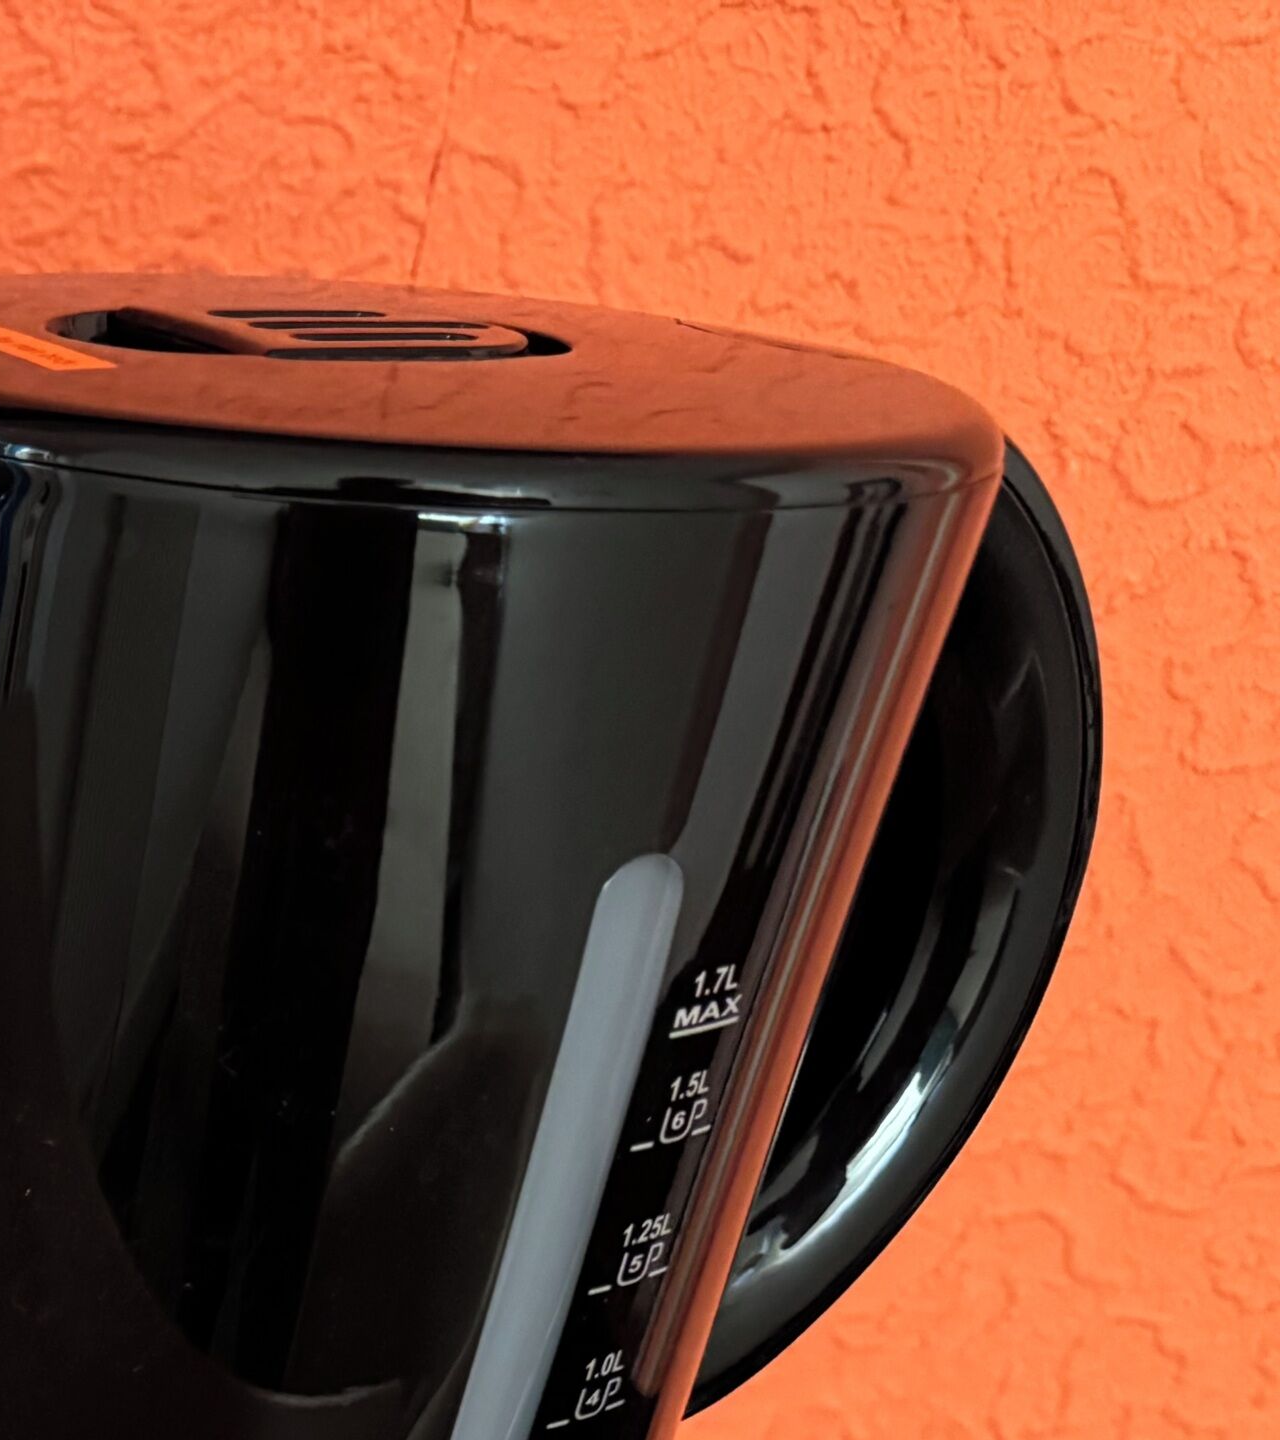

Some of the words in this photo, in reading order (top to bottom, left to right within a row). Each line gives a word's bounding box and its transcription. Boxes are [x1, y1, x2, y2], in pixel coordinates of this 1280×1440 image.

[694, 964, 738, 998] 1.7L
[673, 994, 742, 1029] MAX
[670, 1070, 709, 1102] 1.5L
[671, 1110, 686, 1131] 6
[623, 1213, 672, 1248] 1.25L
[628, 1254, 644, 1274] 5
[585, 1350, 625, 1381] 1.0L
[585, 1388, 601, 1407] 4
